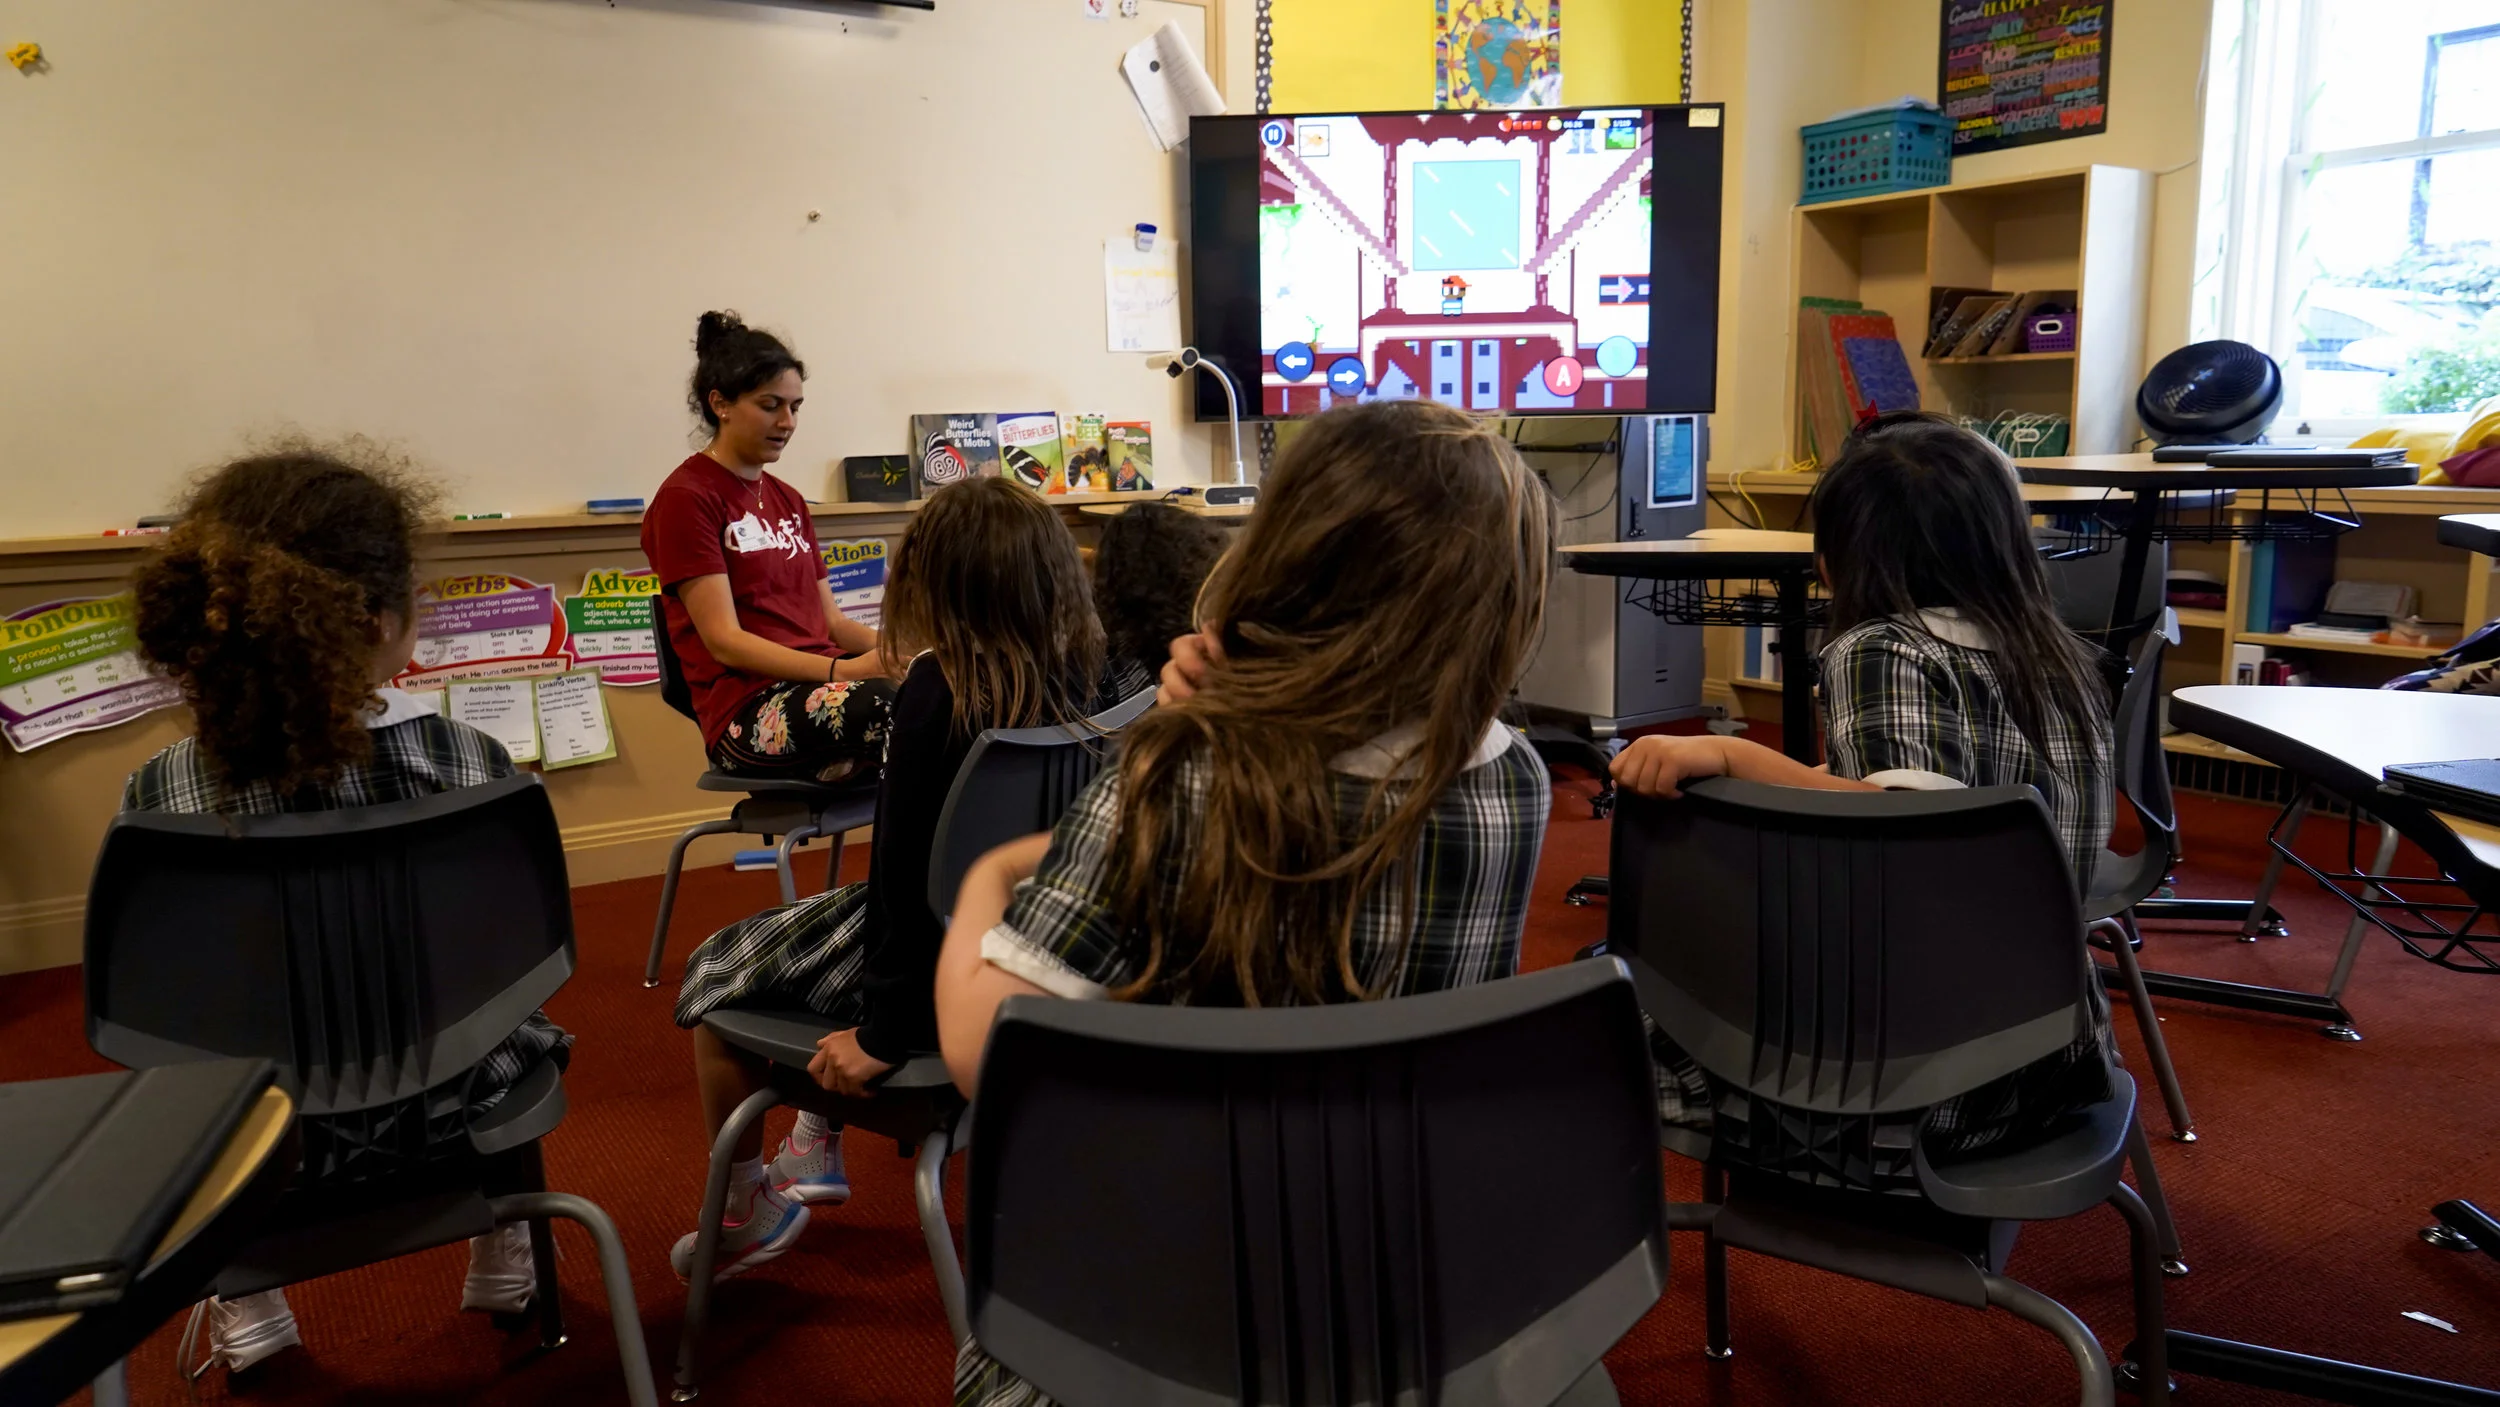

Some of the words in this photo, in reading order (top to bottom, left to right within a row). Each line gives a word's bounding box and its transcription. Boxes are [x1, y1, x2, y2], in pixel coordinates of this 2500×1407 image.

[2059, 104, 2105, 130] WOW
[1954, 131, 1973, 144] ISE
[1556, 364, 1572, 387] A
[947, 419, 974, 429] Weird
[945, 429, 992, 439] Butterflies
[1003, 424, 1055, 443] BUTTERFLIES
[954, 439, 962, 448] &
[964, 438, 991, 448] Moths
[823, 544, 882, 565] ctions
[429, 575, 508, 600] Verbs
[585, 572, 659, 597] Adver
[437, 603, 453, 612] tells
[454, 603, 474, 611] what
[476, 599, 500, 608] action
[501, 595, 535, 606] someone
[595, 600, 624, 609] adverb
[469, 609, 491, 619] doing
[492, 608, 500, 616] or
[502, 604, 540, 615] expresses
[584, 611, 618, 619] adjective,
[630, 609, 650, 617] adver
[438, 622, 447, 630] of
[448, 619, 473, 630] being.
[490, 631, 507, 639] State
[516, 627, 534, 637] Being
[8, 656, 17, 665] A
[17, 643, 62, 665] pronoun
[64, 636, 89, 649] takes
[90, 629, 106, 641] the
[450, 644, 470, 655] jump
[492, 640, 504, 648] am
[493, 648, 505, 656] are
[519, 646, 534, 654] was
[578, 646, 602, 655] quickly
[12, 664, 23, 674] of
[24, 663, 32, 671] a
[33, 655, 57, 669] noun
[58, 652, 67, 661] in
[69, 650, 76, 658] a
[453, 652, 468, 661] talk
[56, 674, 74, 686] you
[95, 662, 112, 674] she
[406, 679, 418, 688] My
[420, 676, 442, 686] horse
[451, 672, 467, 682] fast.
[470, 671, 481, 679] He
[483, 669, 500, 677] runs
[501, 665, 525, 675] across
[527, 663, 540, 672] the
[541, 659, 560, 669] field.
[602, 664, 630, 673] finished
[631, 665, 642, 673] my
[62, 686, 76, 695] we
[97, 673, 119, 686] they
[469, 684, 493, 693] Action
[494, 683, 511, 692] Verb
[538, 679, 564, 691] Linking
[565, 676, 587, 686] Verbs
[44, 716, 63, 729] said
[64, 710, 84, 722] that
[99, 696, 133, 712] wanted
